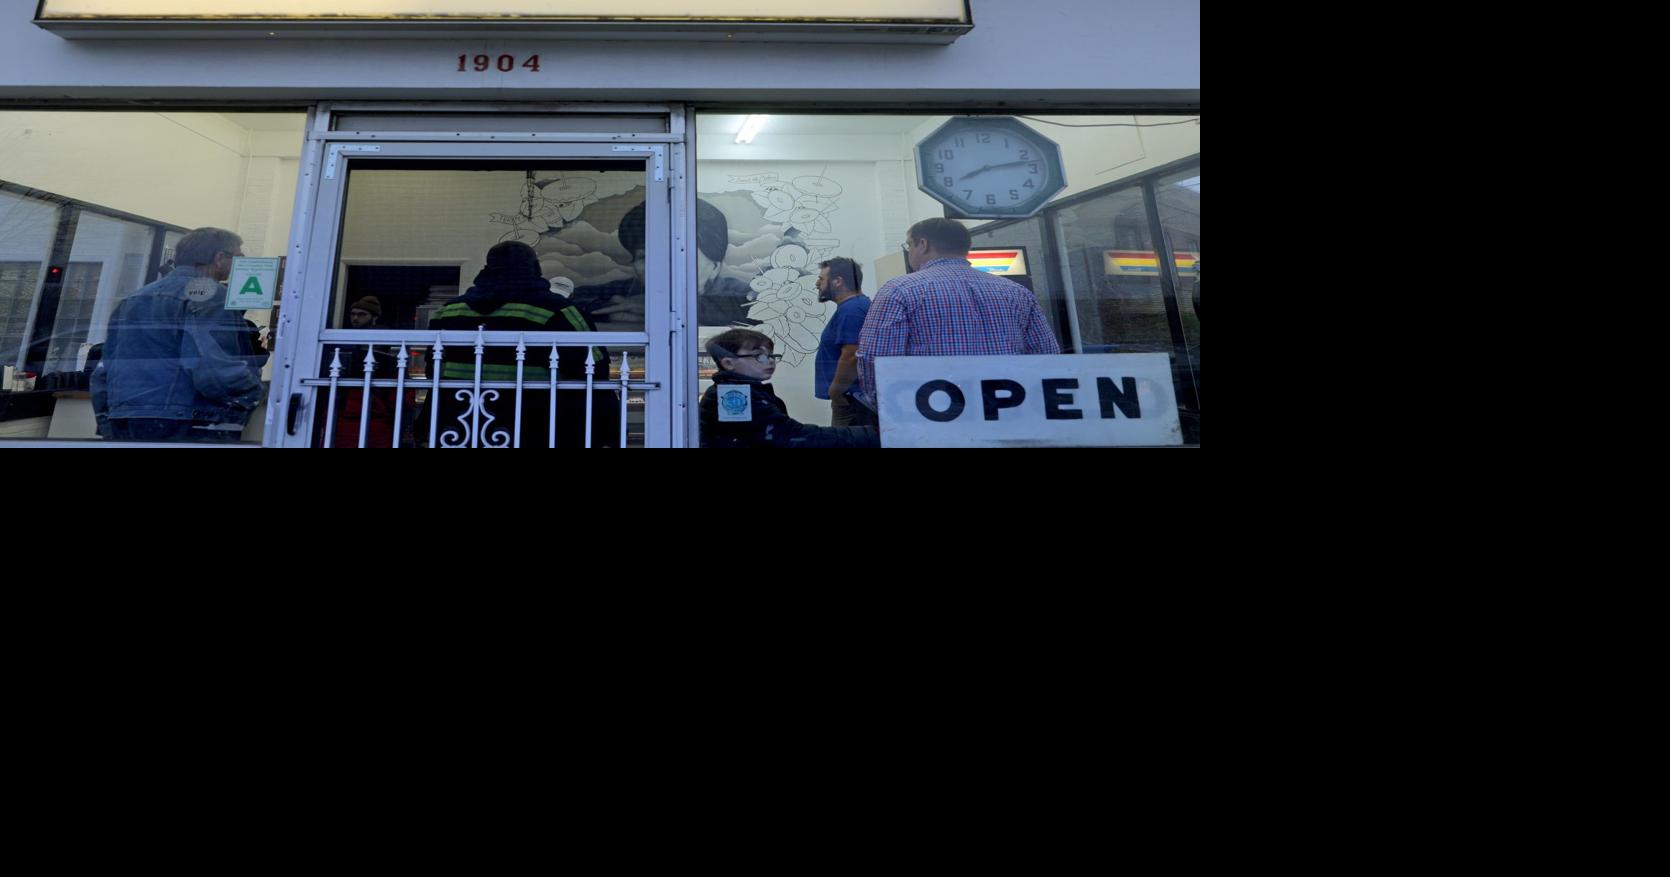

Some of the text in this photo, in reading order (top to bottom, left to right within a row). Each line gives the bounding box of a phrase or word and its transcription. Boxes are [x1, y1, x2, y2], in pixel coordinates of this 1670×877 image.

[457, 54, 540, 72] 1904
[955, 138, 964, 148] 11
[976, 133, 991, 143] 12
[1004, 138, 1008, 148] 1
[938, 150, 954, 160] 10
[1019, 150, 1029, 160] 2
[935, 163, 944, 173] 9
[1028, 164, 1038, 174] 3
[944, 177, 953, 187] 8
[1023, 179, 1034, 189] 4
[963, 190, 973, 200] 7
[986, 194, 996, 205] 6
[1009, 190, 1019, 200] 5
[240, 276, 263, 295] A
[915, 377, 1141, 422] OPEN
